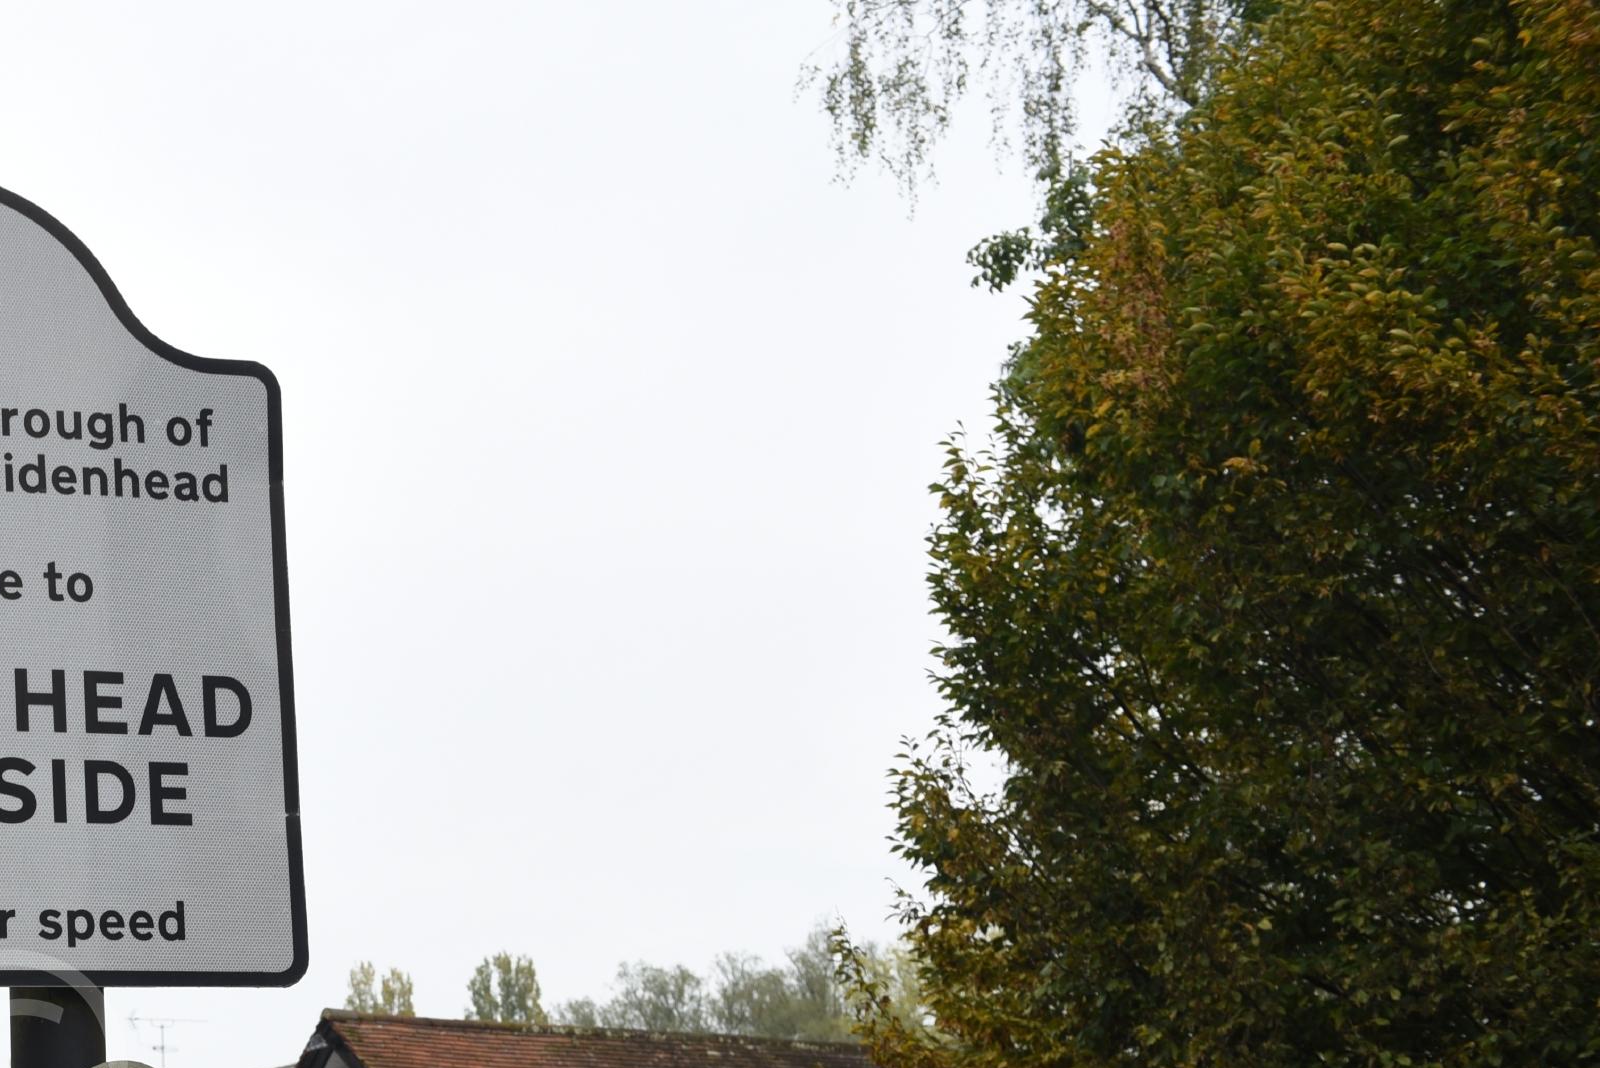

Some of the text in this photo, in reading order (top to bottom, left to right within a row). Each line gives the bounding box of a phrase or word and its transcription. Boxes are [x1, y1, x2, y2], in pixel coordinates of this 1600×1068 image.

[165, 407, 215, 448] of
[43, 561, 95, 603] to
[38, 900, 187, 948] speed
